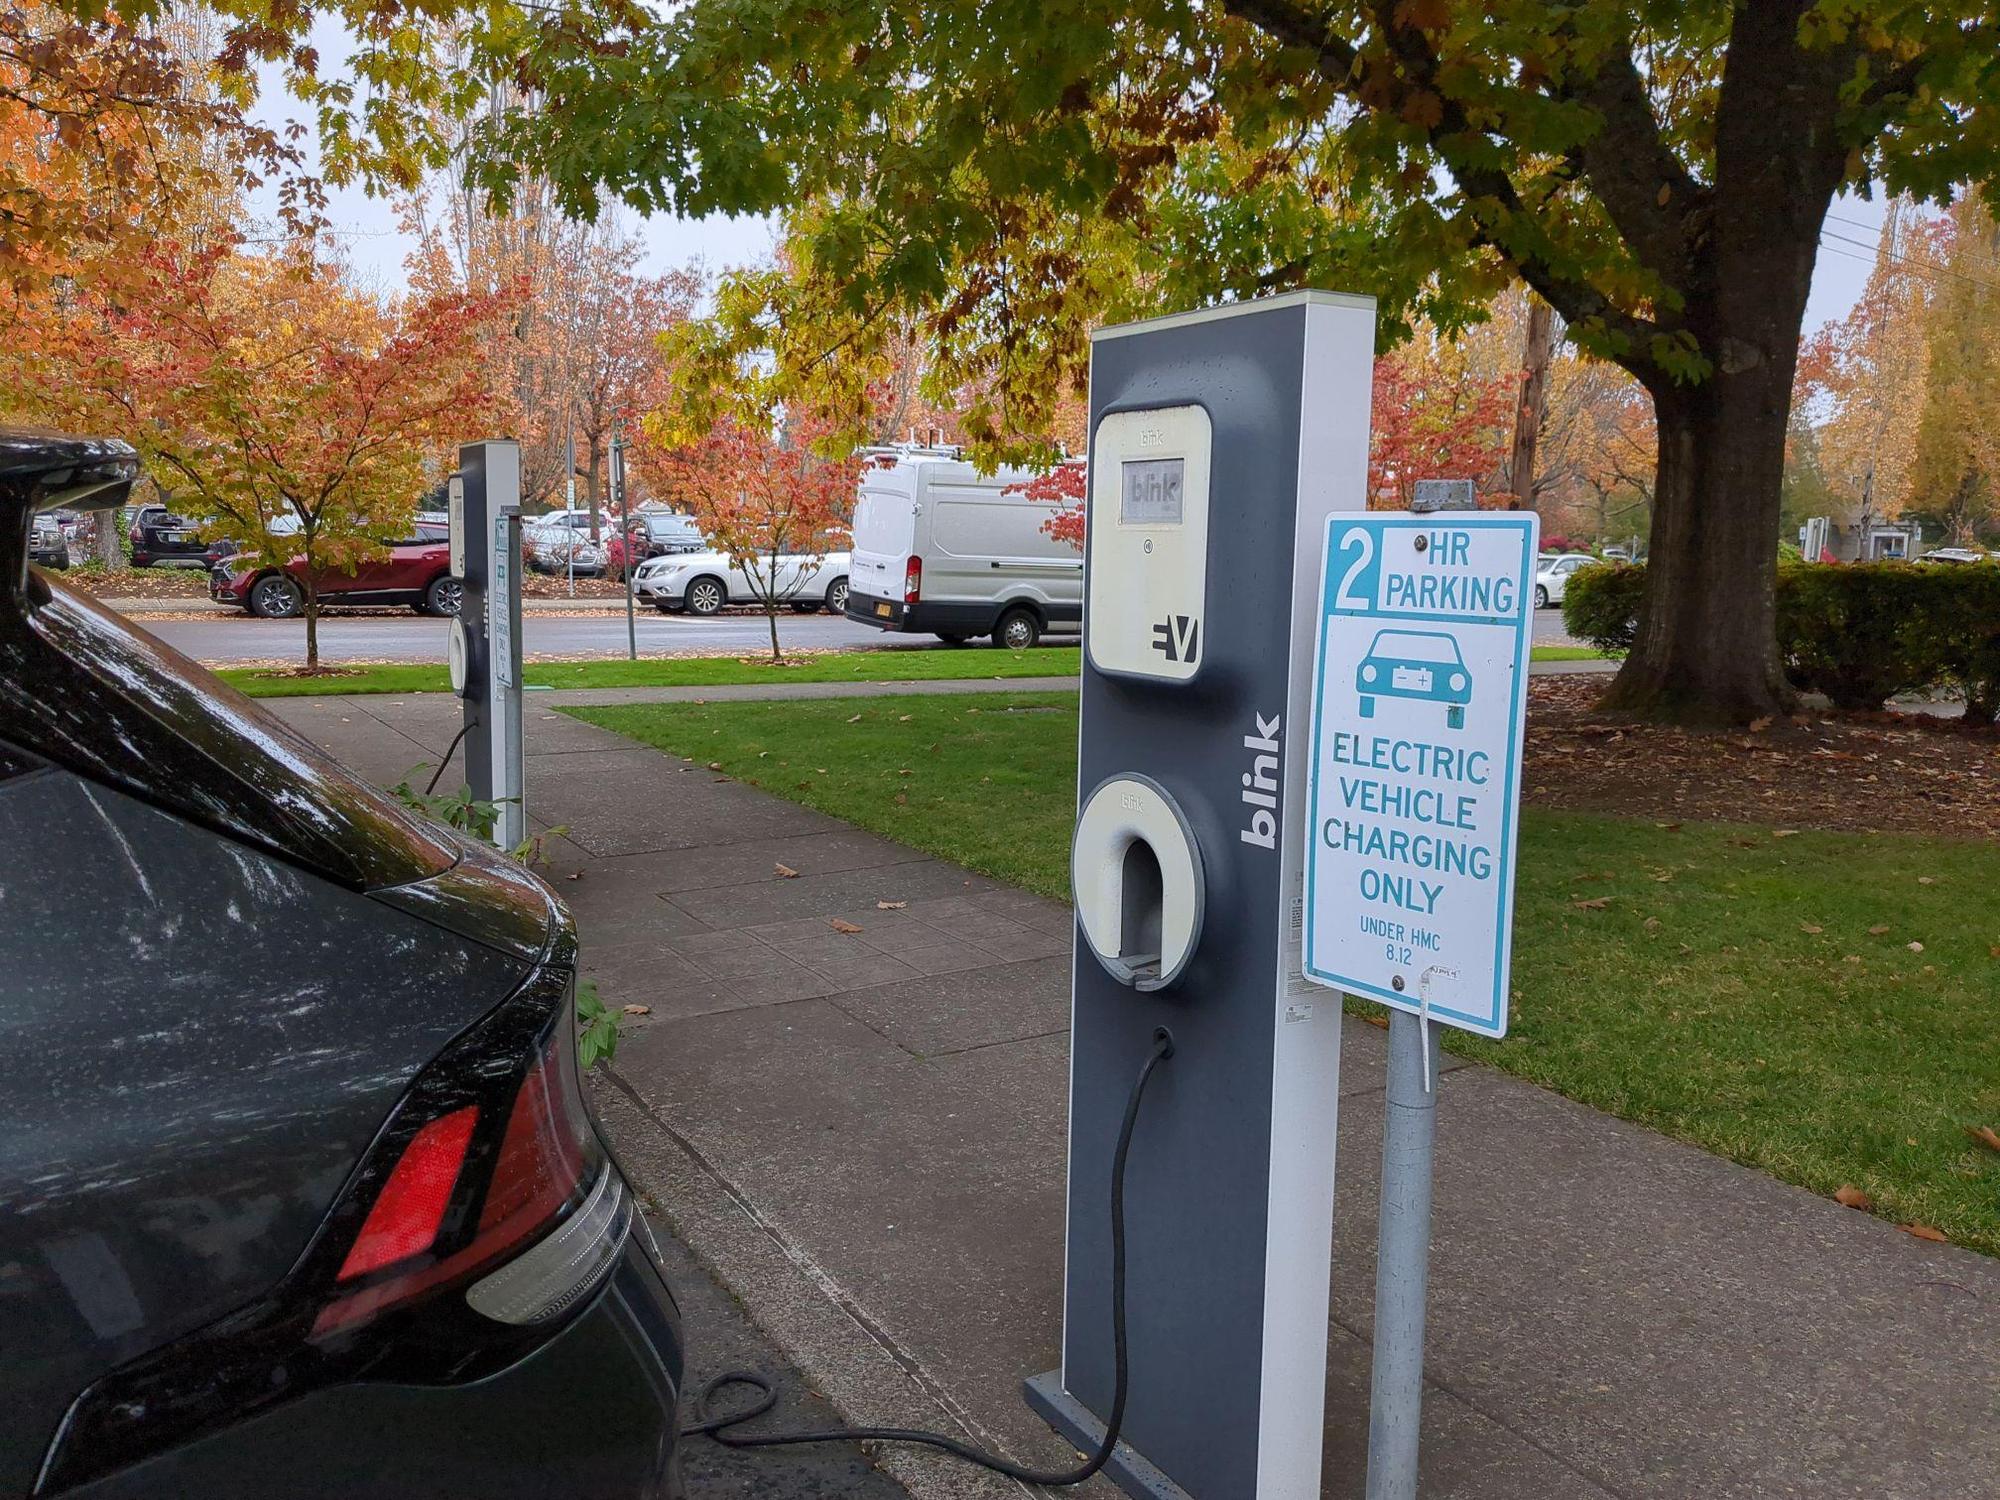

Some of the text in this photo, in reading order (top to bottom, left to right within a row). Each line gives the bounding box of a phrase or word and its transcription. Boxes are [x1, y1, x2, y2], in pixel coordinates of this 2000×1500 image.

[1131, 472, 1177, 502] blink
[1334, 527, 1470, 610] 2 HR
[1386, 573, 1513, 613] PARKING
[1152, 613, 1198, 663] EV
[1241, 710, 1280, 850] blink
[1333, 732, 1489, 785] ELECTRIC
[1340, 776, 1477, 831] VEHICLE
[1323, 817, 1491, 880] CHARGING
[1360, 869, 1444, 915] ONLY
[1360, 915, 1441, 952] UNDER HMC
[1386, 943, 1412, 966] 8.12
